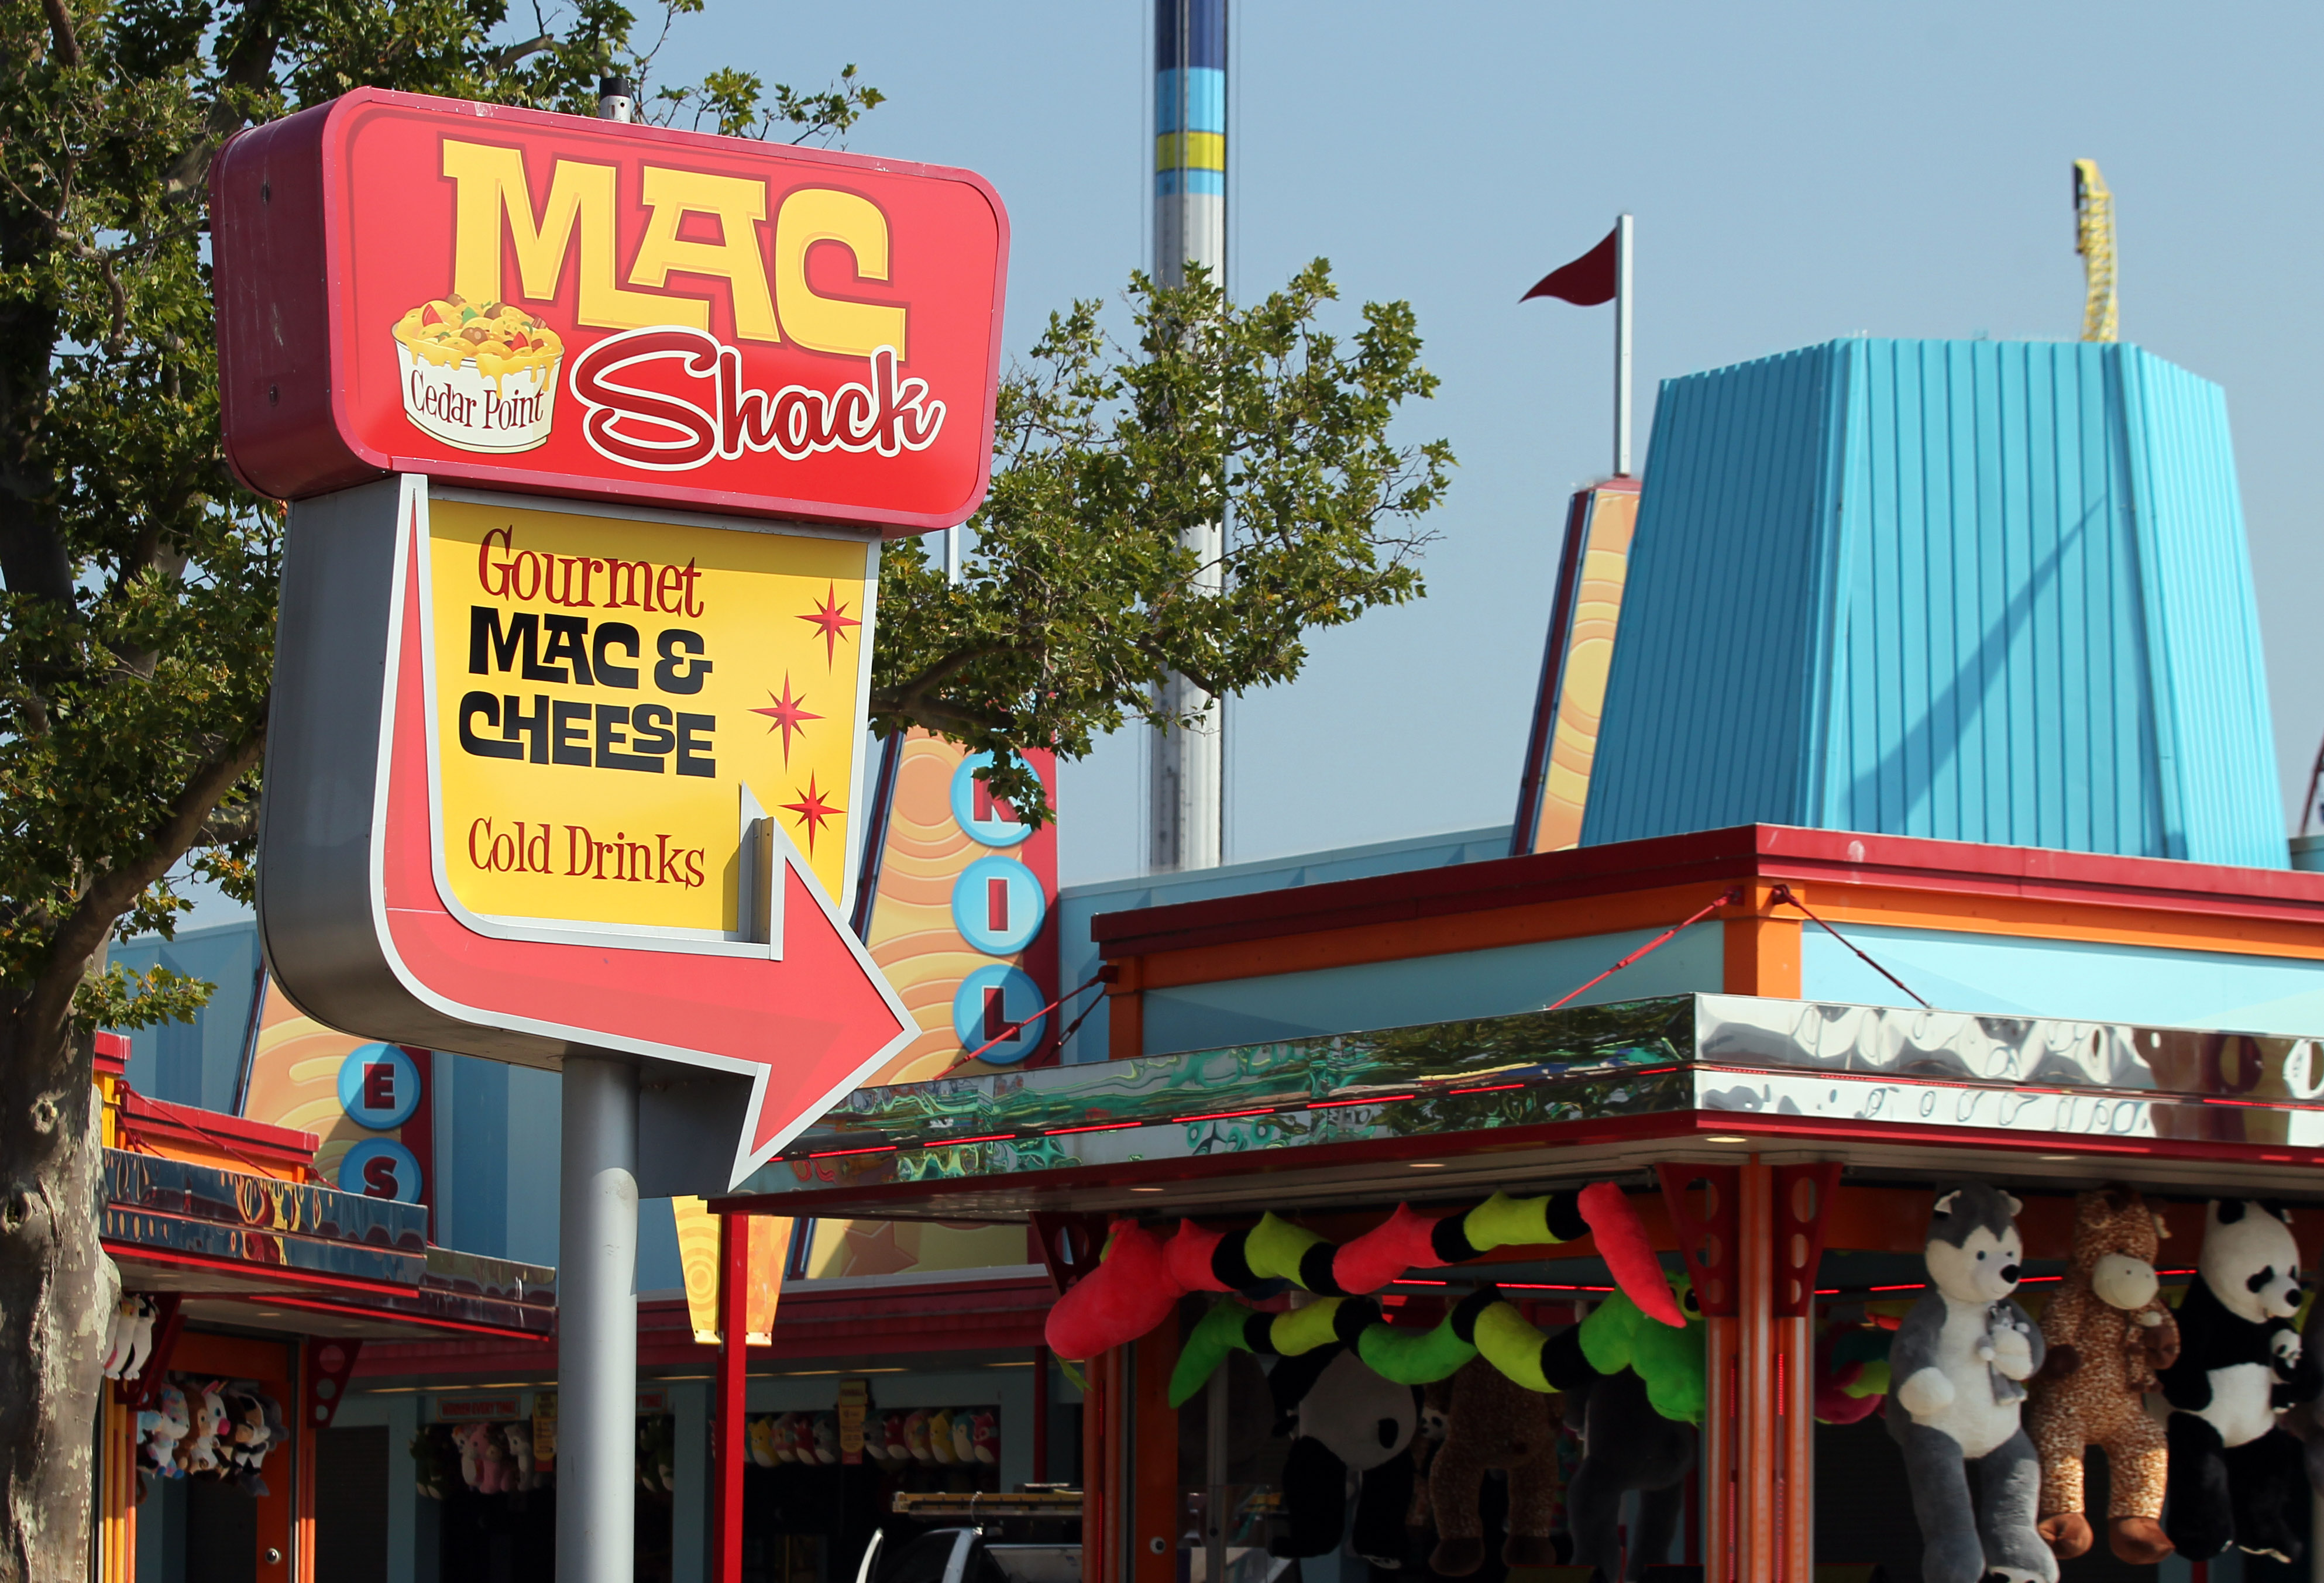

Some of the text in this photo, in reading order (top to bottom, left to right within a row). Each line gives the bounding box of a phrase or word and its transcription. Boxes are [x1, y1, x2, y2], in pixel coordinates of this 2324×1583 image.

[442, 137, 907, 362] MAC
[411, 369, 544, 431] Cedar Point
[571, 325, 946, 470] Shack
[479, 524, 704, 618] Gourmet
[468, 605, 713, 695] MAC &
[458, 690, 717, 779] CHEESE
[469, 816, 706, 890] Cold Drinks
[971, 766, 1026, 1042] KIL
